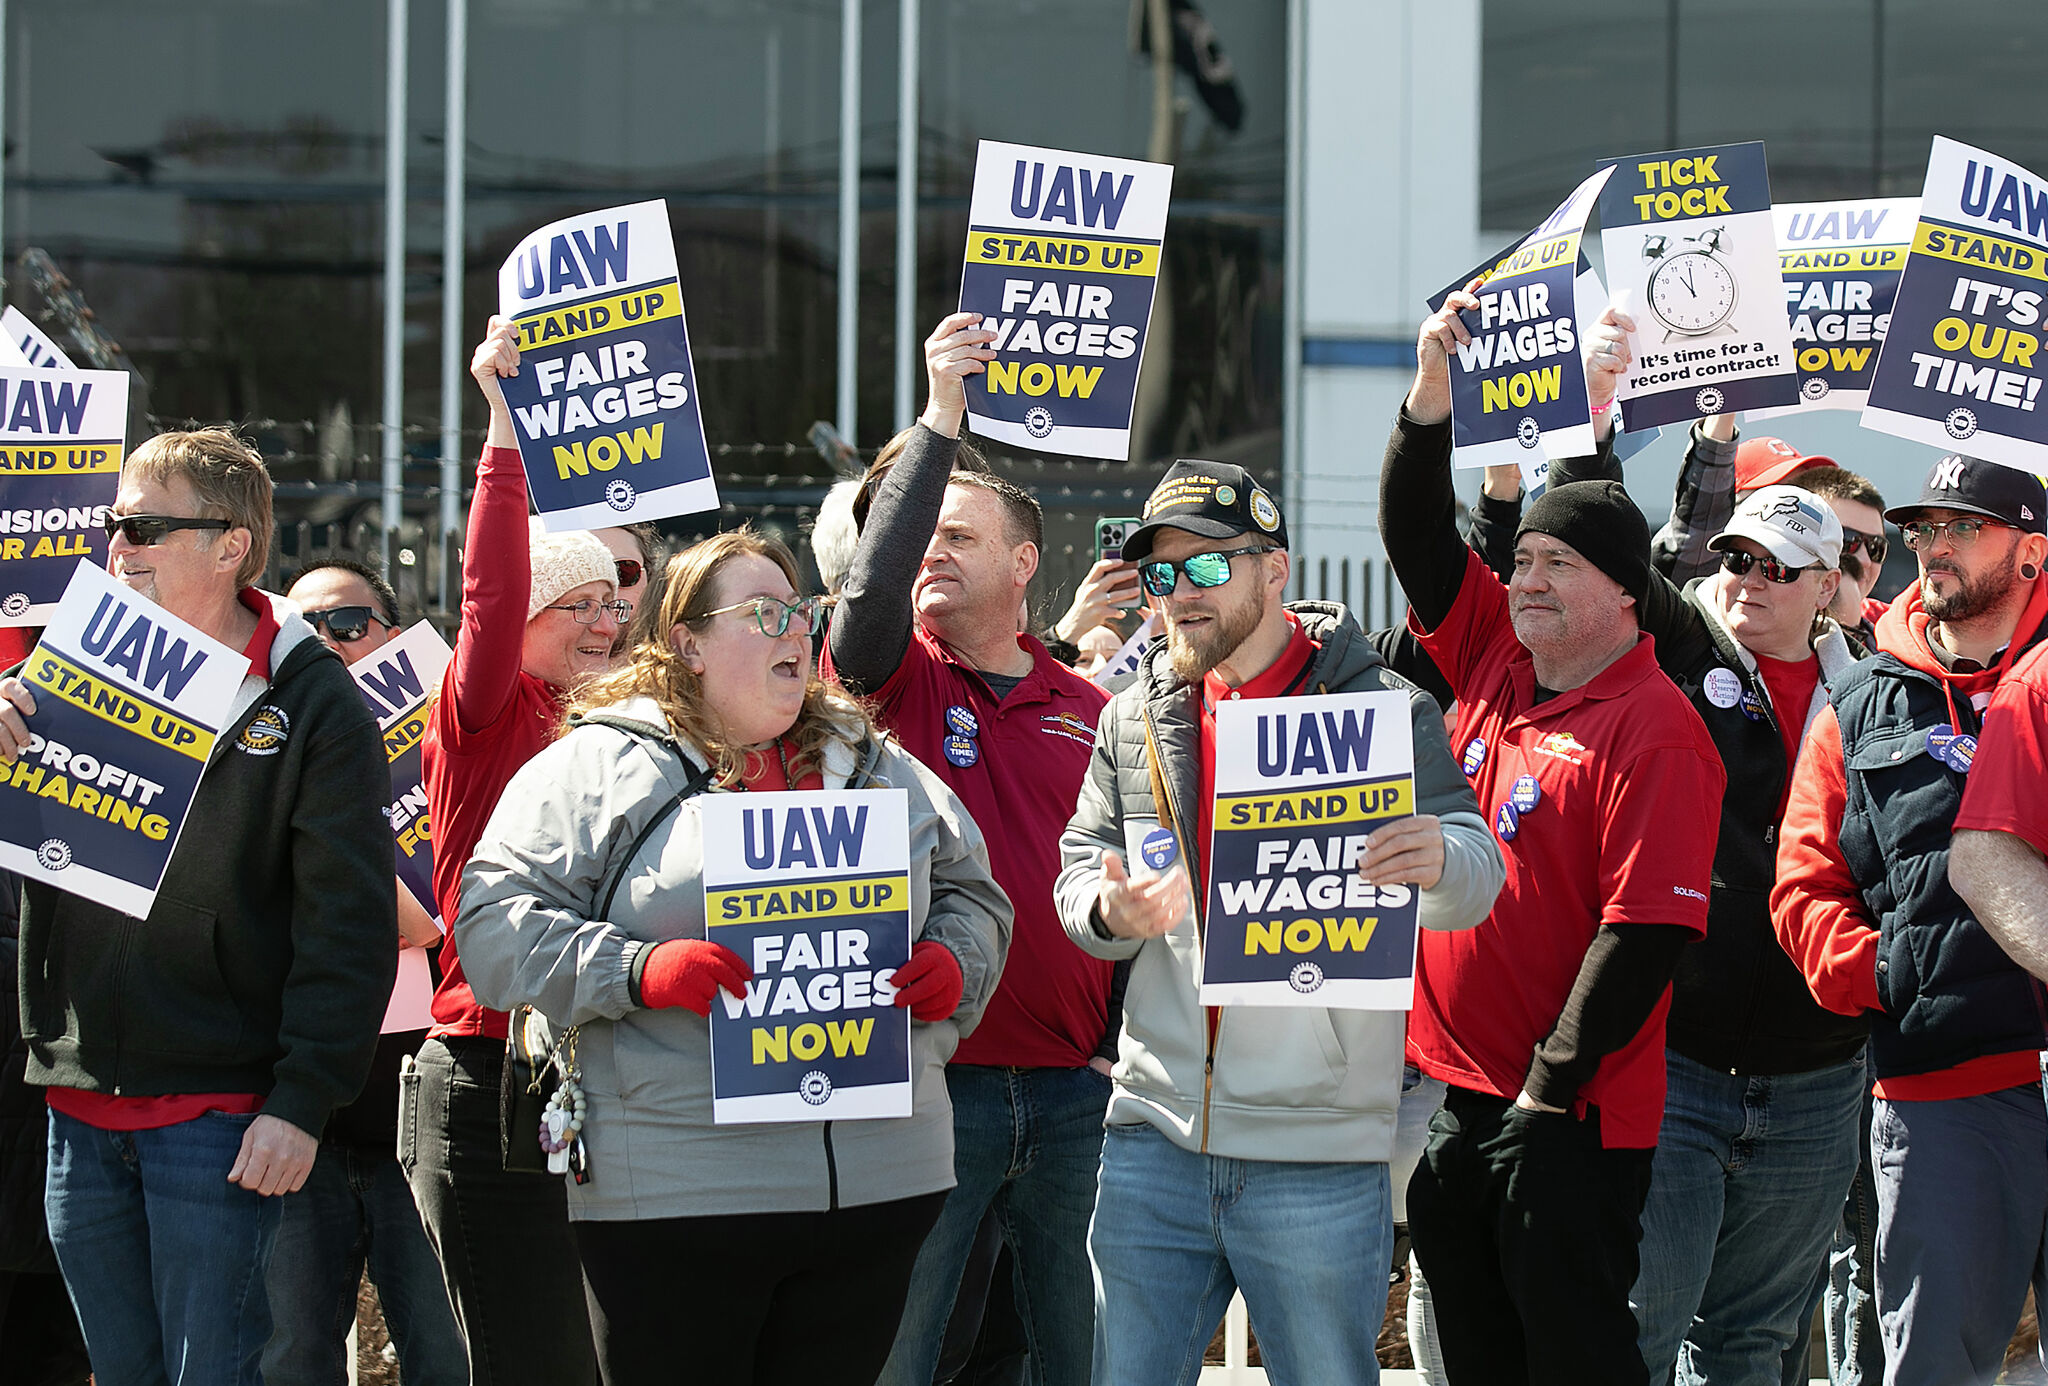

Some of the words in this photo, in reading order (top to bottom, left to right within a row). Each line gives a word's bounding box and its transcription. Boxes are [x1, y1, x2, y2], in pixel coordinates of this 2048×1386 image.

[1638, 155, 1721, 189] TICK
[1011, 160, 1135, 231] UAW
[1634, 185, 1733, 221] TOCK
[1787, 208, 1889, 242] UAW
[518, 220, 629, 300] UAW
[980, 238, 1090, 266] STAND
[1101, 246, 1144, 270] UP
[1541, 239, 1569, 264] UP
[1860, 250, 1896, 266] UP
[1926, 230, 2033, 271] STAND
[620, 292, 664, 322] UP
[1001, 279, 1113, 320] FAIR
[1481, 282, 1550, 331] FAIR
[1949, 277, 2044, 327] IT'S
[1455, 317, 1576, 373] WAGES
[1788, 314, 1890, 342] AGES
[1932, 317, 2039, 369] OUR
[534, 340, 650, 397] FAIR
[1630, 367, 1692, 390] record
[1695, 354, 1780, 376] contract!
[1639, 354, 1669, 369] It's
[1673, 348, 1716, 363] time
[1722, 341, 1749, 355] for
[1753, 343, 1764, 352] a
[1794, 347, 1873, 373] OW
[986, 361, 1105, 400] NOW
[1482, 365, 1562, 414] NOW
[1911, 352, 2043, 412] TIME!
[514, 372, 689, 441] WAGES
[68, 450, 107, 469] UP
[553, 422, 665, 480] NOW
[31, 533, 92, 559] ALL
[1786, 519, 1807, 535] FOX
[81, 592, 209, 702] UAW
[1708, 674, 1739, 686] Members
[1711, 682, 1737, 693] Deserve
[37, 659, 142, 724] STAND
[151, 715, 197, 747] UP
[950, 708, 978, 730] WAGES
[952, 716, 972, 731] NOW
[1257, 708, 1375, 778] UAW
[951, 741, 971, 749] OUR
[18, 732, 165, 806] PROFIT
[1230, 794, 1348, 826] STAND
[1359, 787, 1400, 814] UP
[742, 804, 869, 870] UAW
[721, 888, 838, 920] STAND
[849, 883, 893, 908] UP
[1218, 874, 1412, 916] WAGES
[752, 928, 870, 975] FAIR
[1244, 917, 1379, 956] NOW
[751, 1017, 876, 1066] NOW
